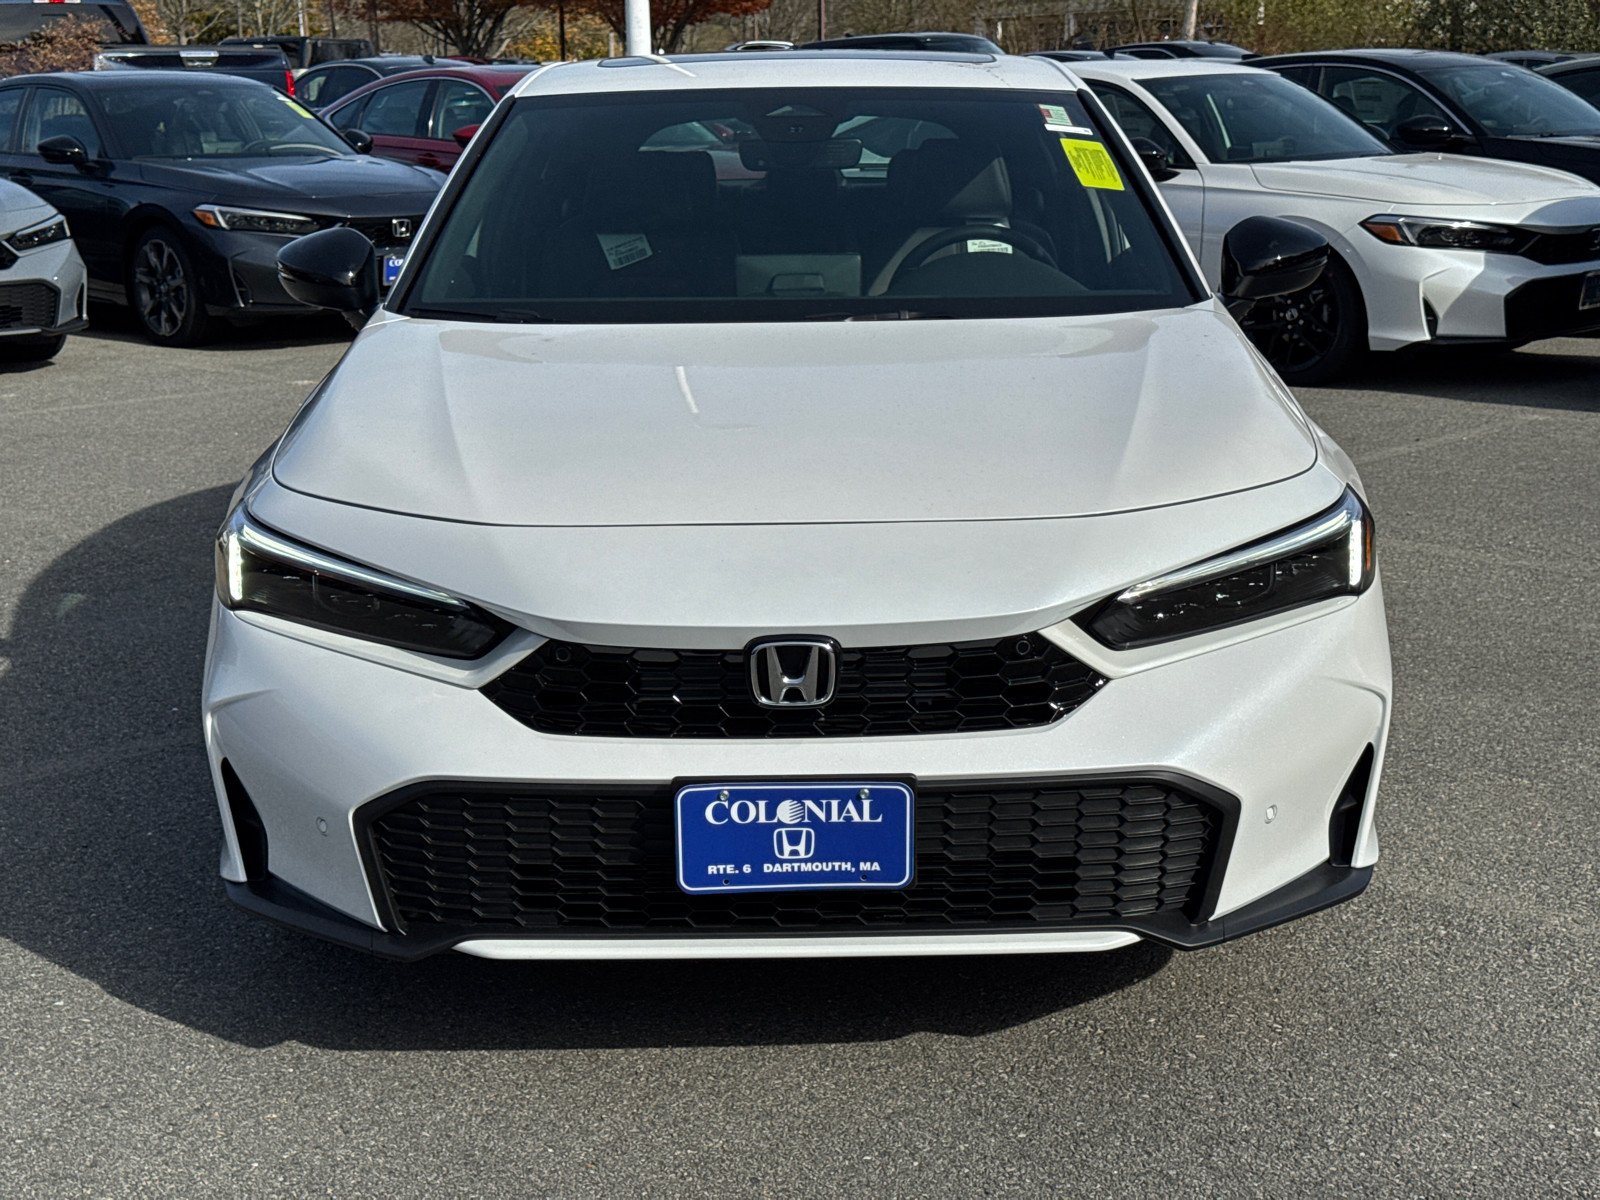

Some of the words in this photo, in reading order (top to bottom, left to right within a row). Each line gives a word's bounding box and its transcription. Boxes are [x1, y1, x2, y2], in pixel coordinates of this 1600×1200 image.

[704, 799, 883, 825] COLONIAL
[707, 864, 739, 875] RTE.
[742, 864, 752, 874] 6
[763, 861, 856, 873] DARTMOUTH,
[859, 861, 881, 872] MA
